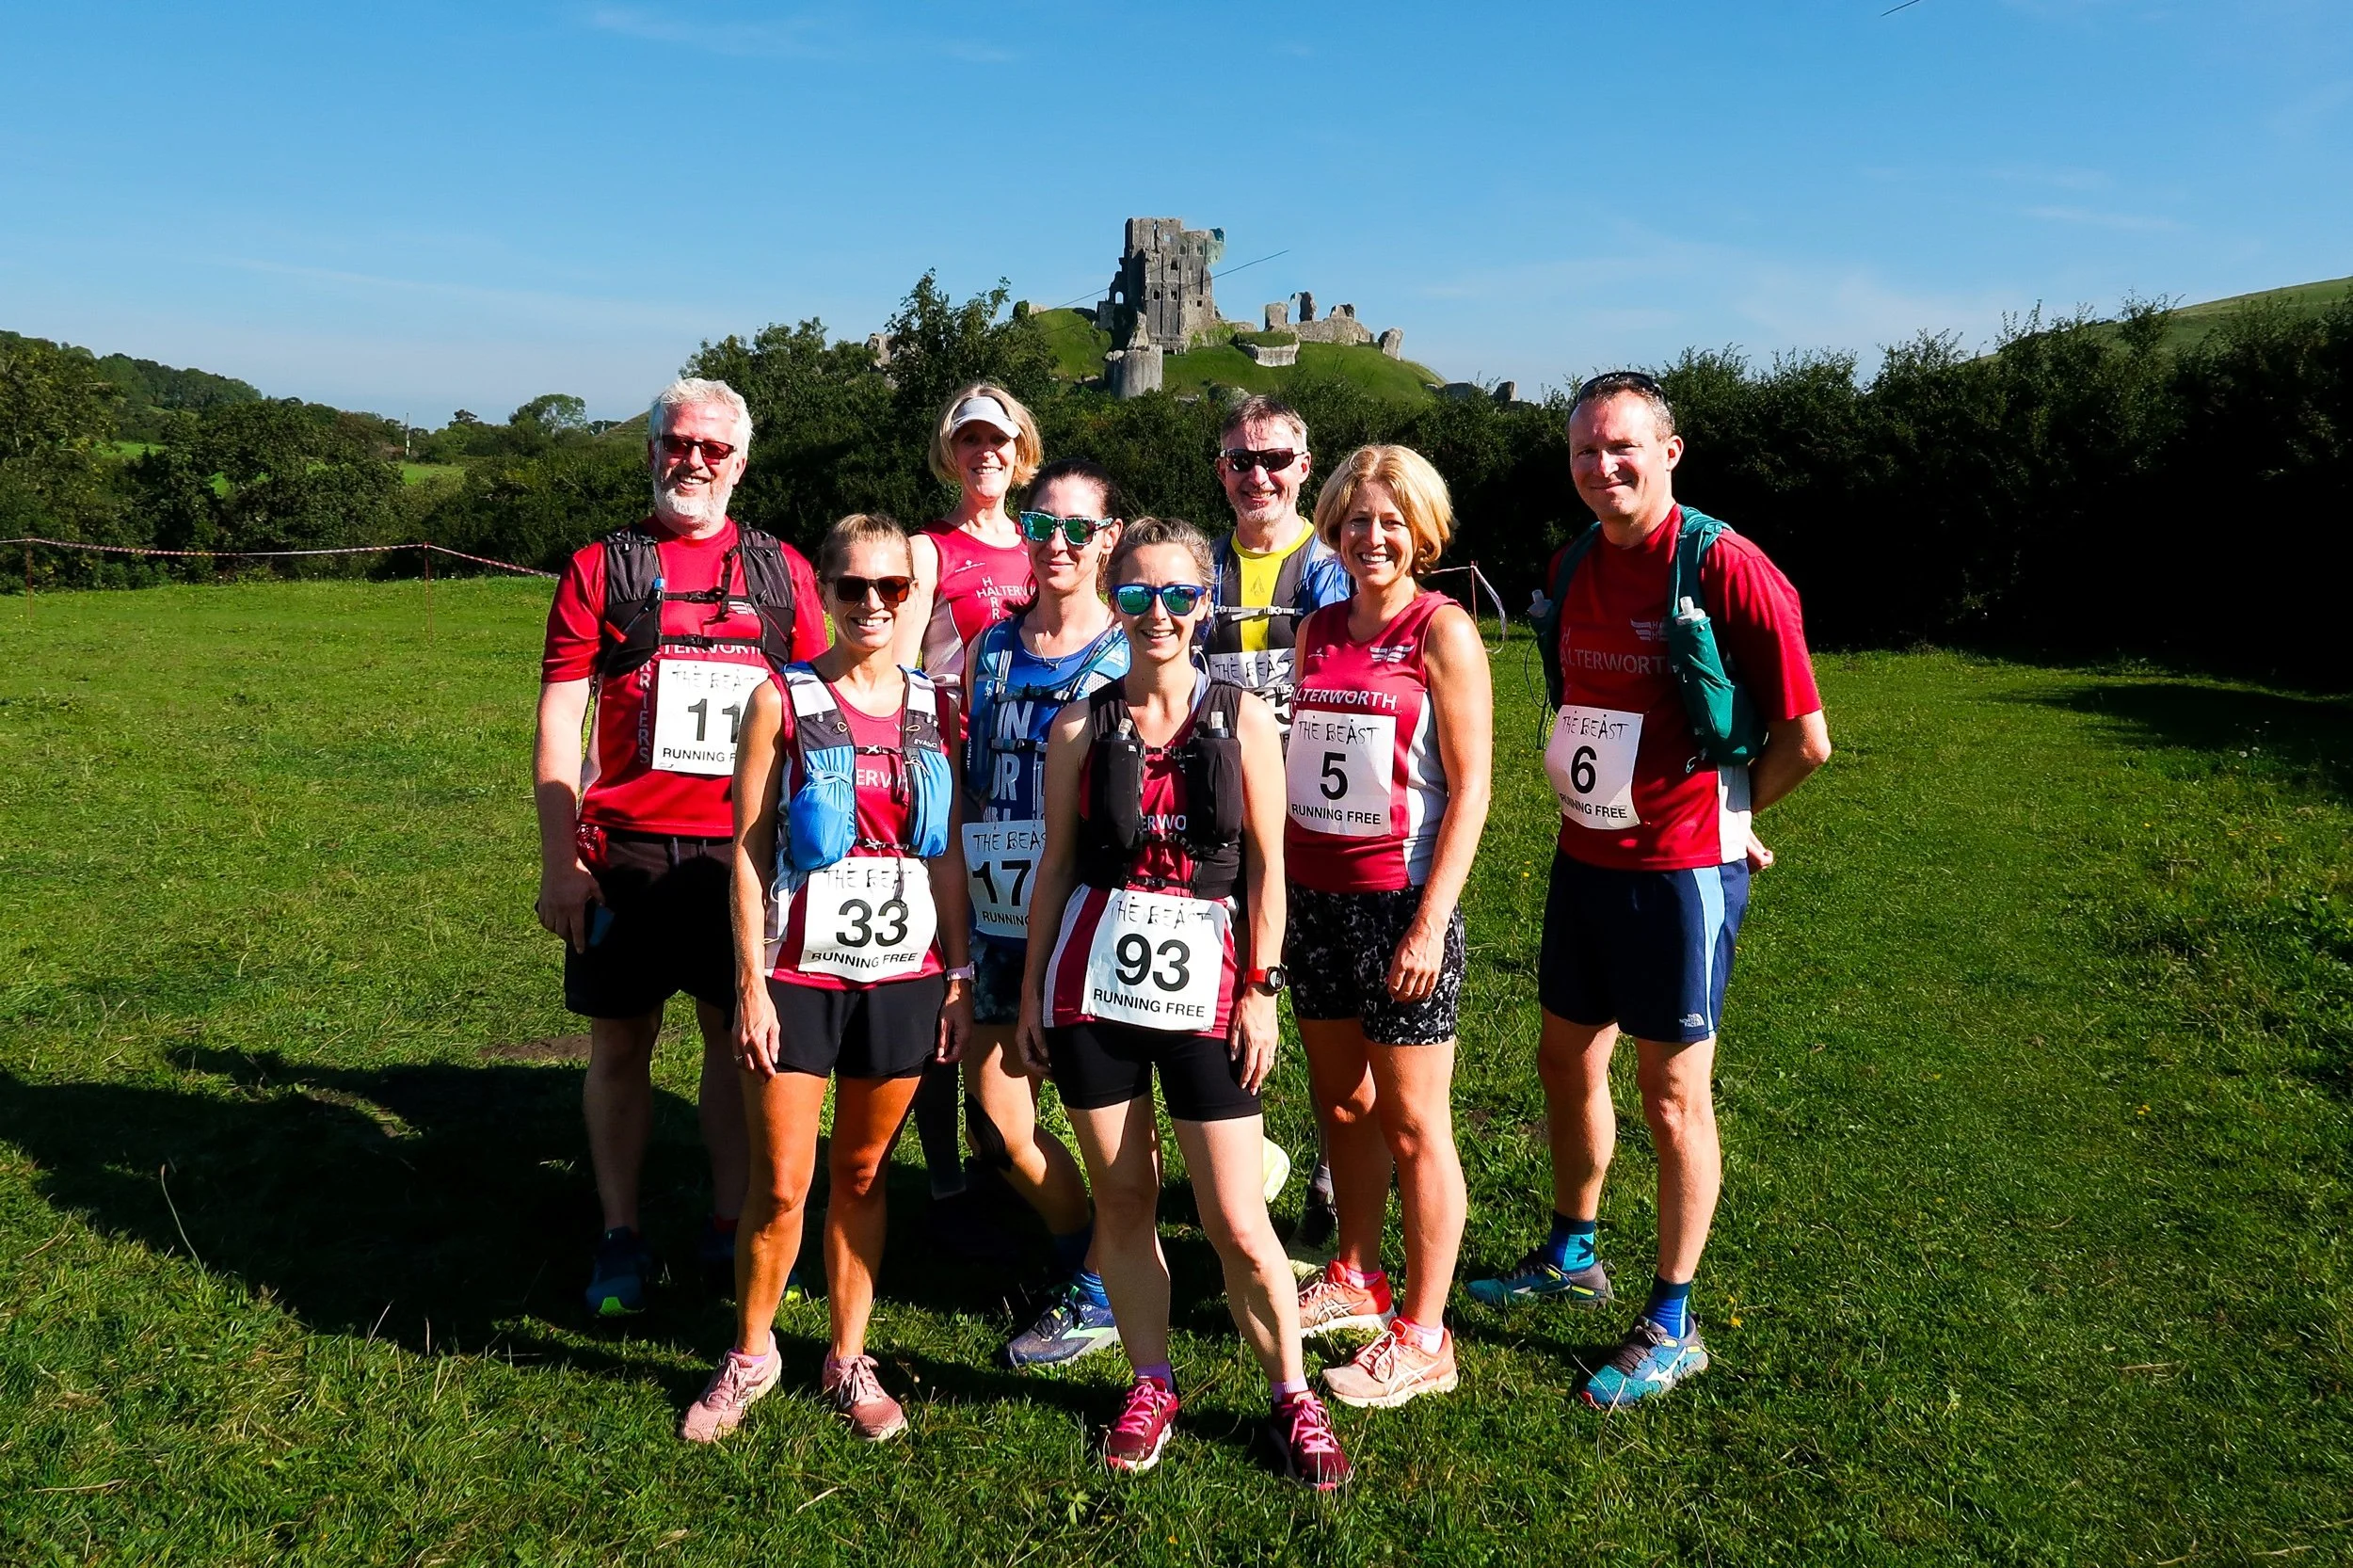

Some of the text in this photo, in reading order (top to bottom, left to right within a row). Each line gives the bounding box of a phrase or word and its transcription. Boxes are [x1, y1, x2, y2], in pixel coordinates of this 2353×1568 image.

[688, 698, 741, 744] 11
[1299, 721, 1321, 741] THE
[1325, 723, 1380, 744] BEAST
[1562, 716, 1629, 740] THE BEAST
[663, 747, 725, 762] RUNNING
[1320, 751, 1348, 801] 5
[1571, 745, 1597, 794] 6
[1291, 804, 1381, 824] RUNNING FREE
[1595, 806, 1627, 818] FREE
[973, 834, 1001, 852] THE
[972, 859, 1032, 906] 17
[836, 899, 909, 948] 33
[811, 952, 919, 968] RUNNING FREE
[1115, 934, 1190, 992] 93
[1094, 988, 1206, 1018] RUNNING FREE
